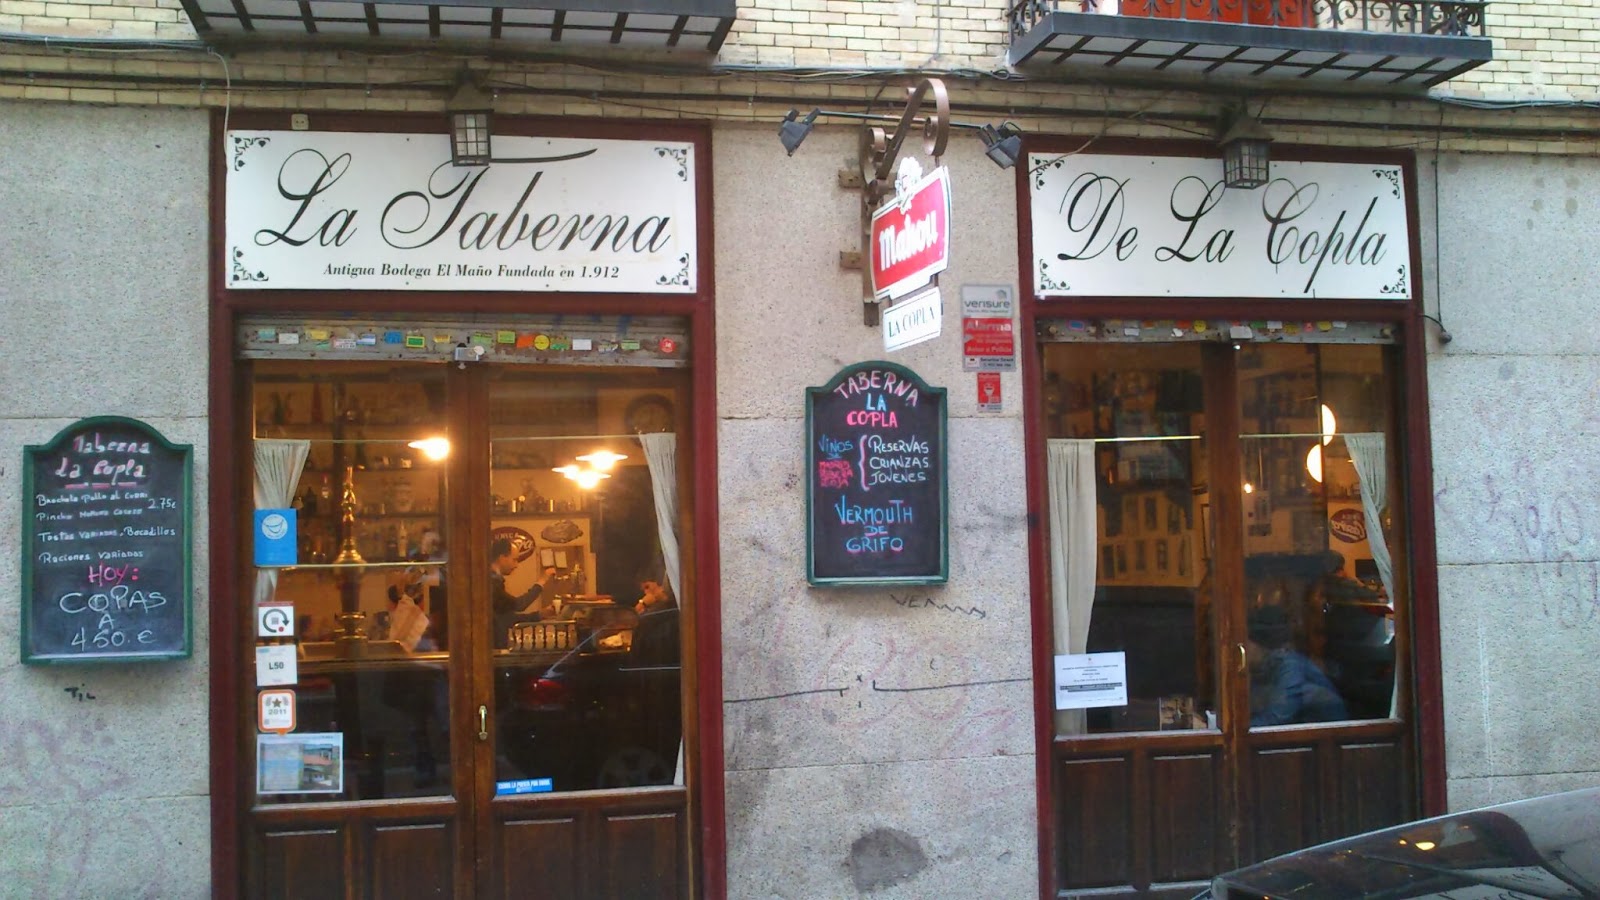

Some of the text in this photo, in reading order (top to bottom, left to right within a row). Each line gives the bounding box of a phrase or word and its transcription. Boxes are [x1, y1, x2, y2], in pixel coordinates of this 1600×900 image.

[254, 148, 671, 253] La Taberna
[879, 210, 938, 271] Mahou
[1057, 172, 1388, 293] De La Copla
[323, 263, 620, 279] Antigua Bodega El Maño Fundada en 1.912
[964, 300, 1011, 309] verisure
[888, 307, 936, 339] LA COPLA
[833, 370, 919, 407] TABERNA
[866, 392, 888, 412] LA
[846, 411, 898, 428] COPLA
[73, 432, 150, 453] Taberna
[868, 434, 930, 454] RESERVAS
[55, 457, 147, 486] La Copla
[869, 455, 929, 470] CRIANZAS
[868, 471, 926, 486] JOVENES
[834, 494, 913, 525] VERMOUTH
[864, 525, 889, 536] DE
[846, 537, 904, 552] GRIFO
[39, 551, 91, 563] Raciones
[59, 585, 167, 614] COPAS
[98, 613, 115, 630] A
[137, 630, 156, 644] €
[268, 708, 287, 716] 2011
